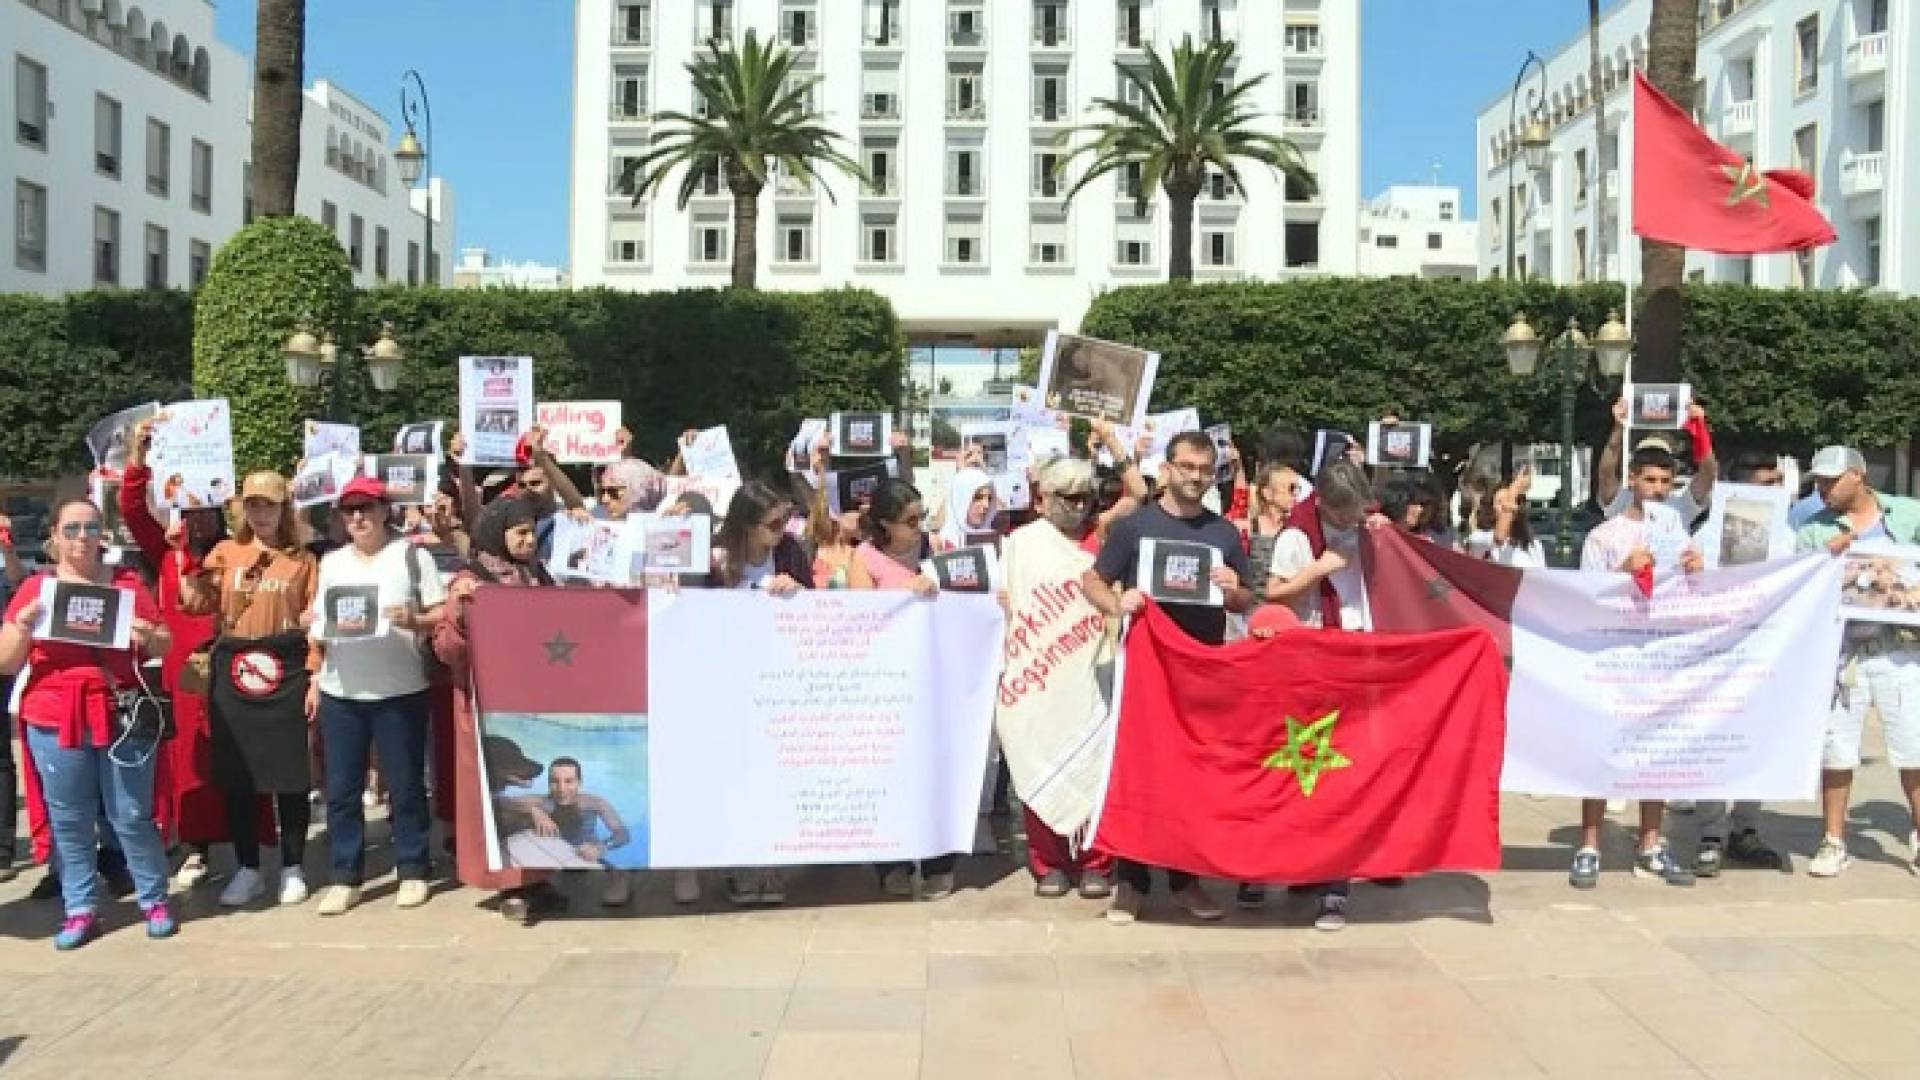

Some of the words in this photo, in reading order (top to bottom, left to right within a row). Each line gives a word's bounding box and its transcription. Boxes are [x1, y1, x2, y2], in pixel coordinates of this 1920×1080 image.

[540, 405, 606, 433] Killing
[1009, 580, 1082, 658] opkillin
[998, 614, 1105, 706] dogsinmoro
